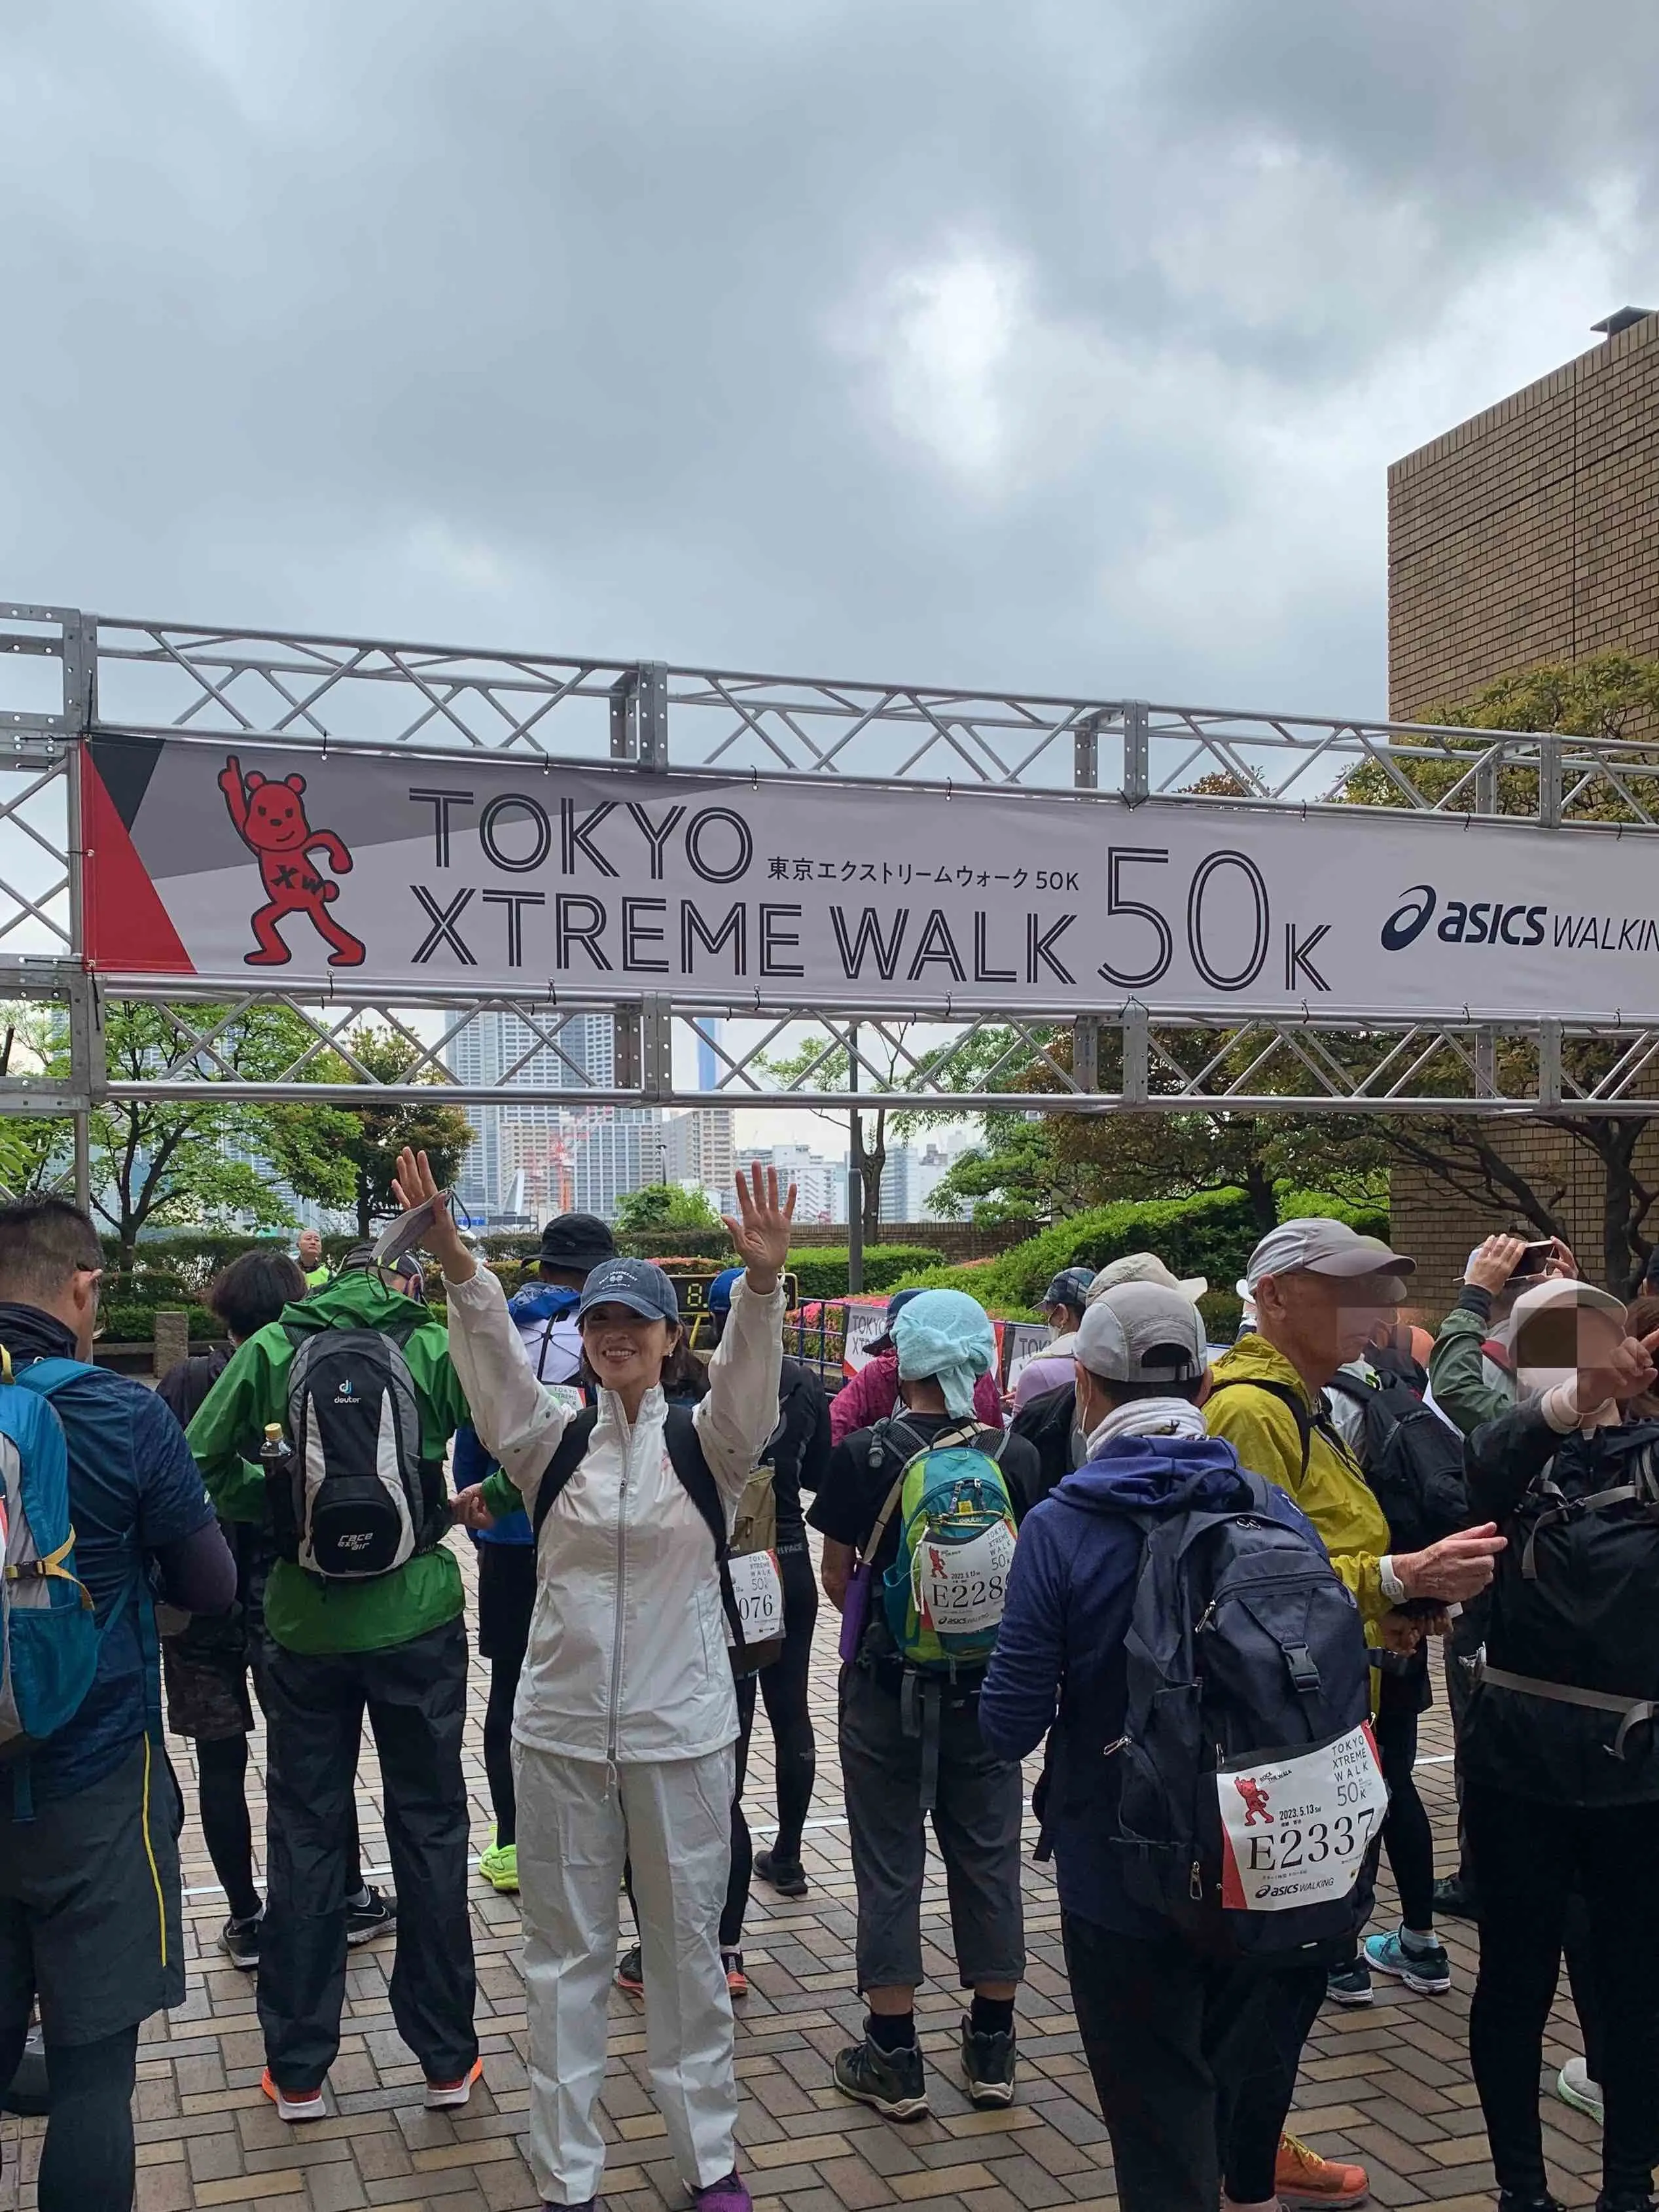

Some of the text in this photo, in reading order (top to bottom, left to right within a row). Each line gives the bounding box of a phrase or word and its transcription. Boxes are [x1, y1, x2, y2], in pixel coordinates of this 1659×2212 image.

[409, 787, 753, 884] TOKYO
[766, 857, 1080, 891] 東京エクストリームウォーク 50K
[410, 885, 804, 977] XTREME
[830, 906, 1078, 984] WALK
[1437, 901, 1547, 947] asics
[1332, 1735, 1365, 1755] TOKYO
[1332, 1748, 1367, 1770] XTREME
[1334, 1762, 1368, 1783] WALK
[1247, 1808, 1374, 1870] E2337
[1299, 1878, 1335, 1892] WALKING
